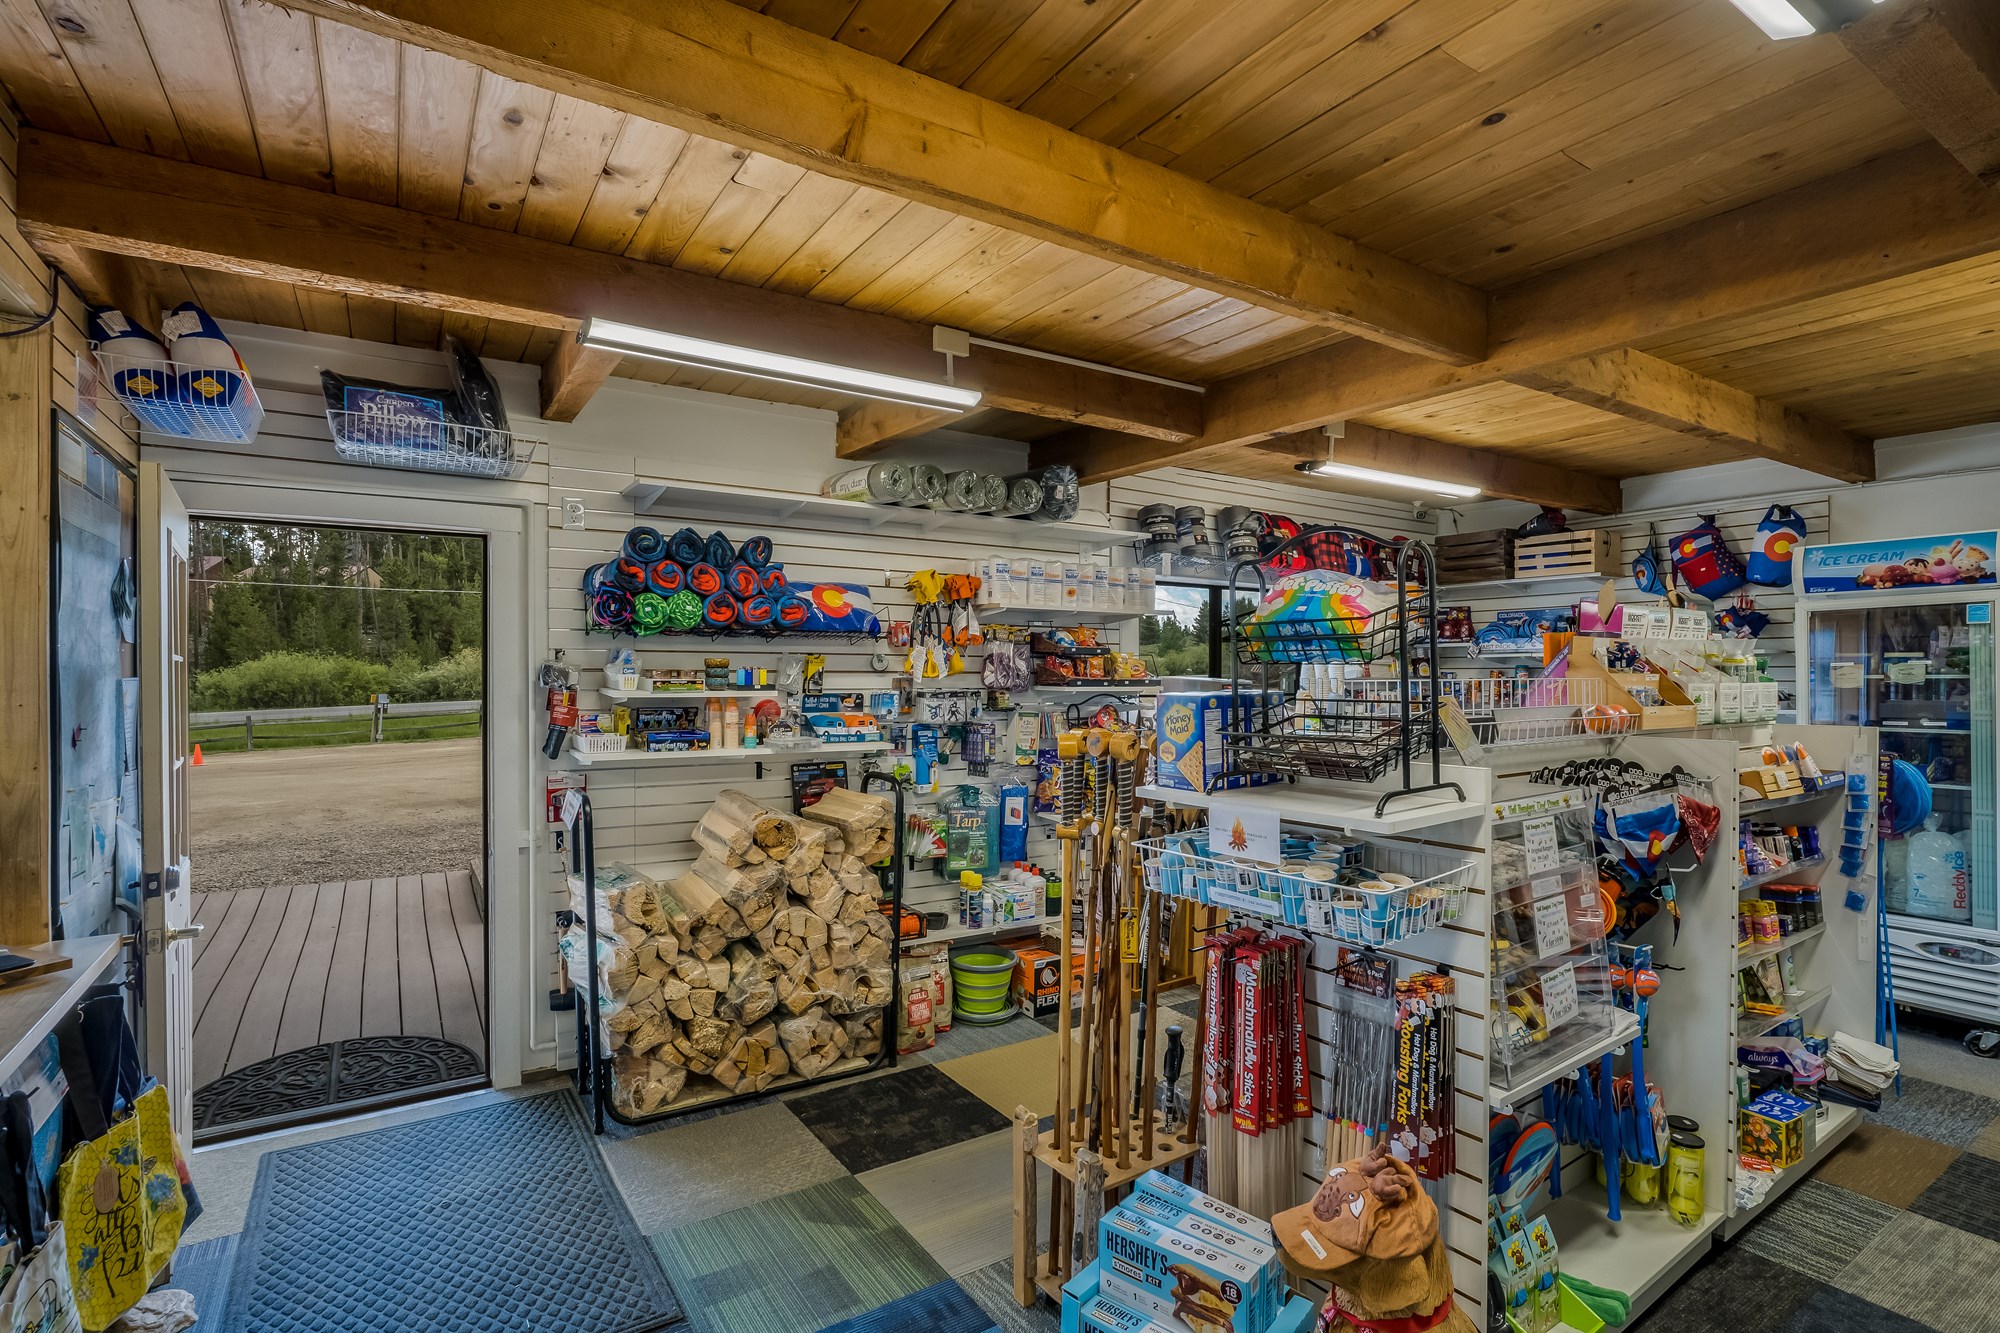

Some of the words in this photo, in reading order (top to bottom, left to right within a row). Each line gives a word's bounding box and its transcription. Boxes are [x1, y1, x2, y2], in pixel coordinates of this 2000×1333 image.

[377, 394, 414, 408] Campers
[360, 401, 428, 428] Pillow
[1818, 555, 1844, 567] ICE
[1846, 550, 1906, 565] CREAM
[1274, 576, 1364, 598] Jet-Puffed
[639, 714, 663, 722] Mystical
[663, 713, 677, 721] Fire
[1165, 712, 1191, 726] Honey
[1169, 724, 1189, 736] Maid
[677, 742, 689, 750] Fire
[1598, 779, 1609, 787] DOG
[1620, 787, 1640, 798] COLLAR
[1609, 797, 1633, 807] BANDANA
[953, 813, 981, 830] Tarp
[1913, 888, 1919, 897] 7
[1371, 970, 1383, 978] Pack
[1037, 986, 1059, 996] RHINO
[1037, 995, 1059, 1007] FLEX
[1209, 964, 1218, 1052] Marshmallow
[1244, 970, 1257, 1069] Marshmallow
[1397, 1019, 1413, 1083] Roasting
[1412, 1047, 1420, 1061] Dog
[1429, 1041, 1437, 1055] Dog
[1747, 1053, 1779, 1065] always
[1293, 1055, 1303, 1088] Sticks
[1245, 1070, 1255, 1105] Sticks
[1411, 1070, 1419, 1116] Marshmallow
[1428, 1063, 1436, 1110] Marshmallow
[1397, 1084, 1411, 1125] Forks
[1136, 1194, 1184, 1217] HERSHEY'S
[1189, 1216, 1203, 1225] MORE
[1105, 1230, 1168, 1276] HERSHEY'S
[1252, 1246, 1264, 1255] 18
[1113, 1259, 1143, 1280] s'mores
[1146, 1276, 1161, 1288] KIT
[1234, 1263, 1246, 1272] 18
[1106, 1279, 1112, 1288] 9
[1225, 1286, 1237, 1299] 18
[1094, 1299, 1142, 1327] HERSHEY'S
[1153, 1302, 1159, 1311] 2
[1091, 1310, 1116, 1325] s'mores
[1116, 1322, 1129, 1331] KIT
